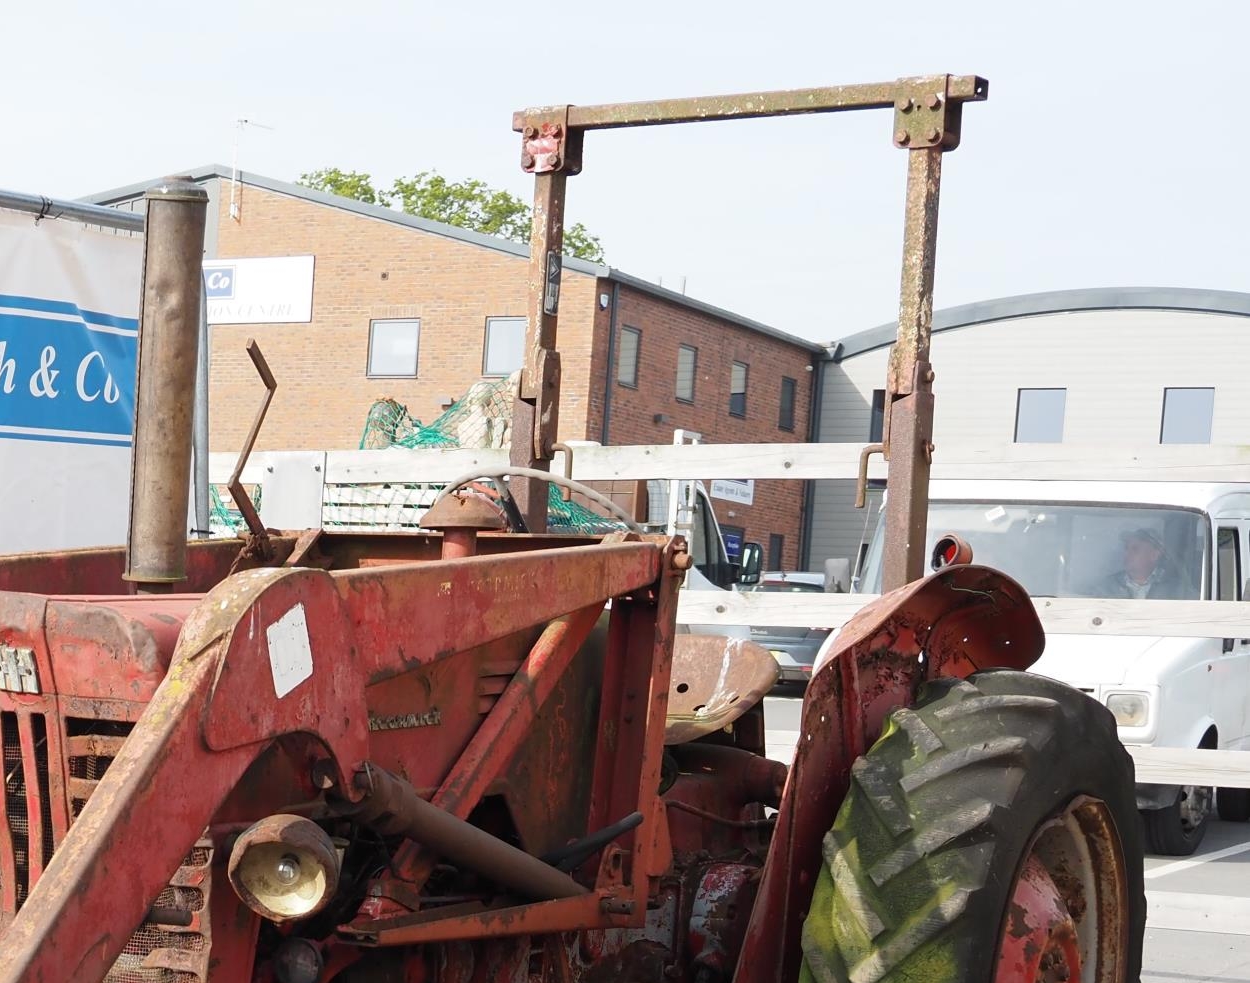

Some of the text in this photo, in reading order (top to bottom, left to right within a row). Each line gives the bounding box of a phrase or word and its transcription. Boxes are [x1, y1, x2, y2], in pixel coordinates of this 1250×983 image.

[208, 272, 230, 289] Co
[29, 345, 60, 399] &
[76, 350, 120, 404] Co
